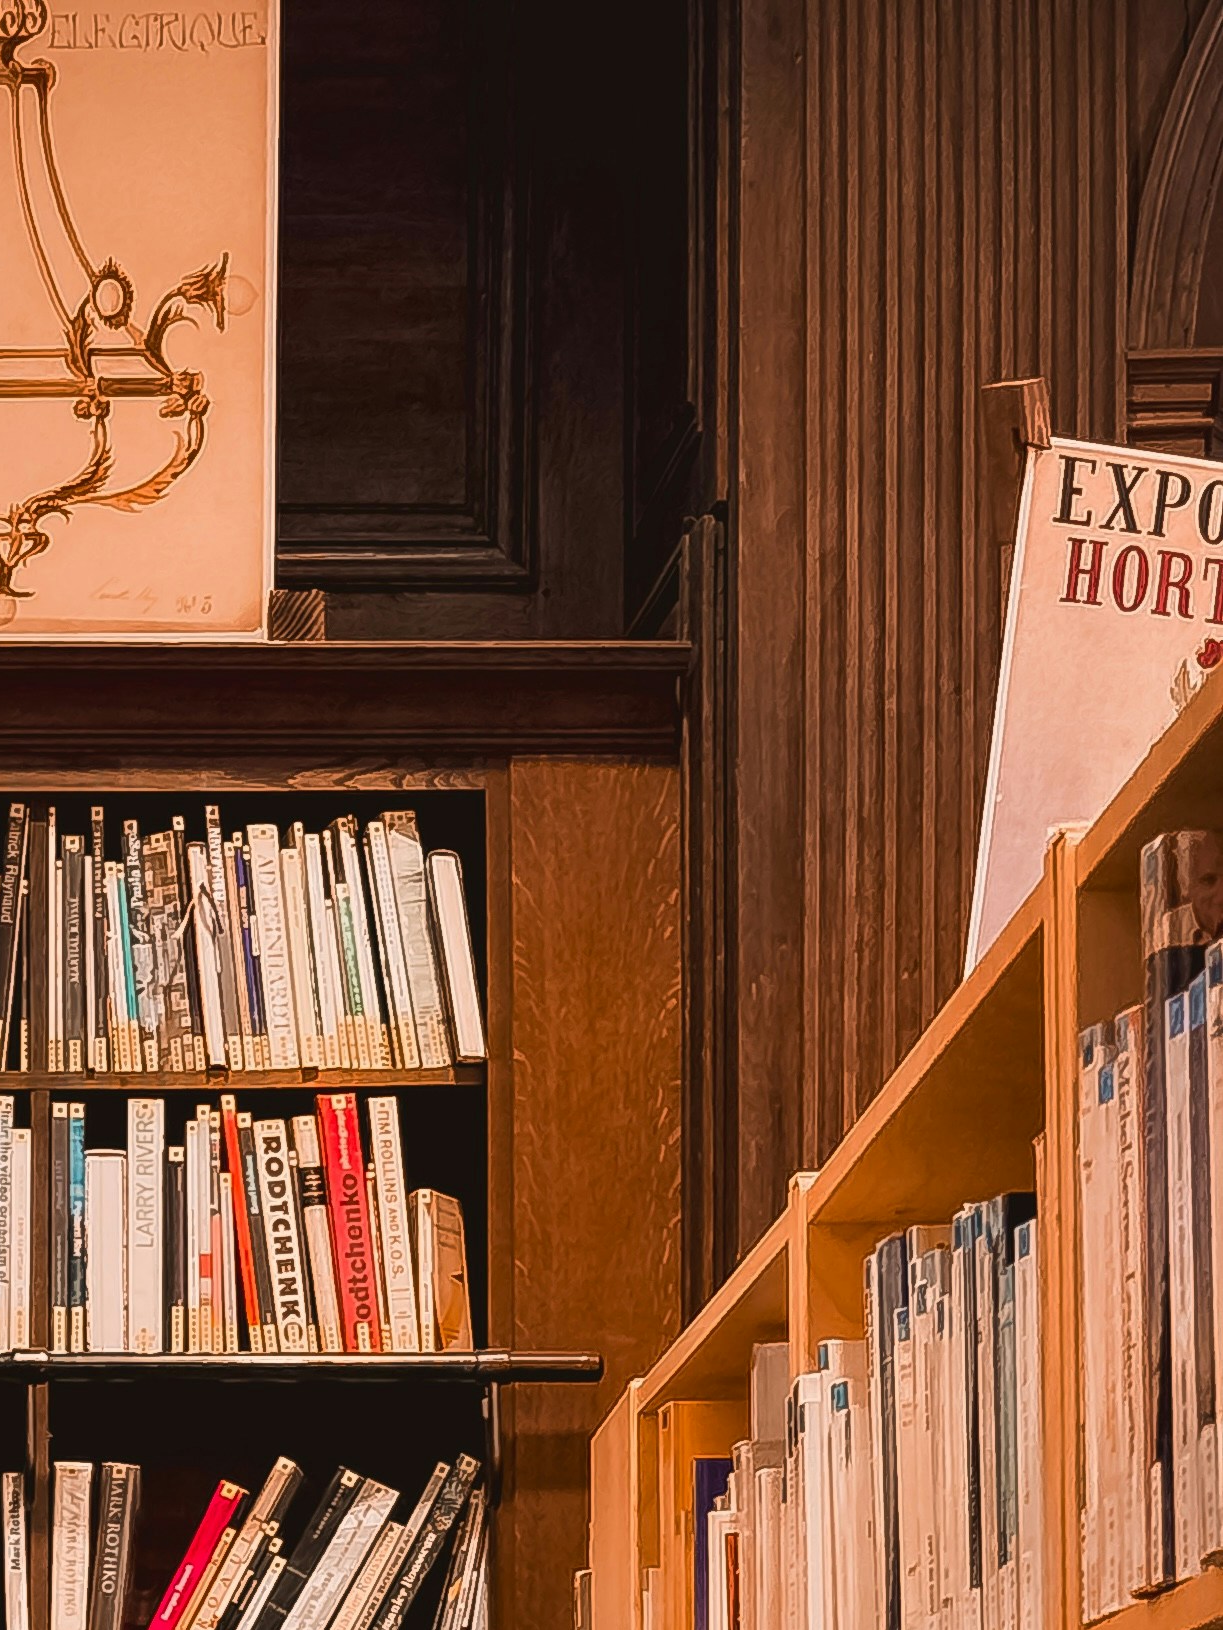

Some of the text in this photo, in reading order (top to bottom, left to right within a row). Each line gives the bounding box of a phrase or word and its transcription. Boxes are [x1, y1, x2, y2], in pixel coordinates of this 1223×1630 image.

[0, 864, 19, 923] Raynaud
[134, 1108, 155, 1249] LARRY RIVERS
[379, 1137, 399, 1204] ROLLINS
[387, 1207, 399, 1232] AND
[8, 1537, 23, 1571] Mark
[101, 1522, 121, 1594] ROTHKO
